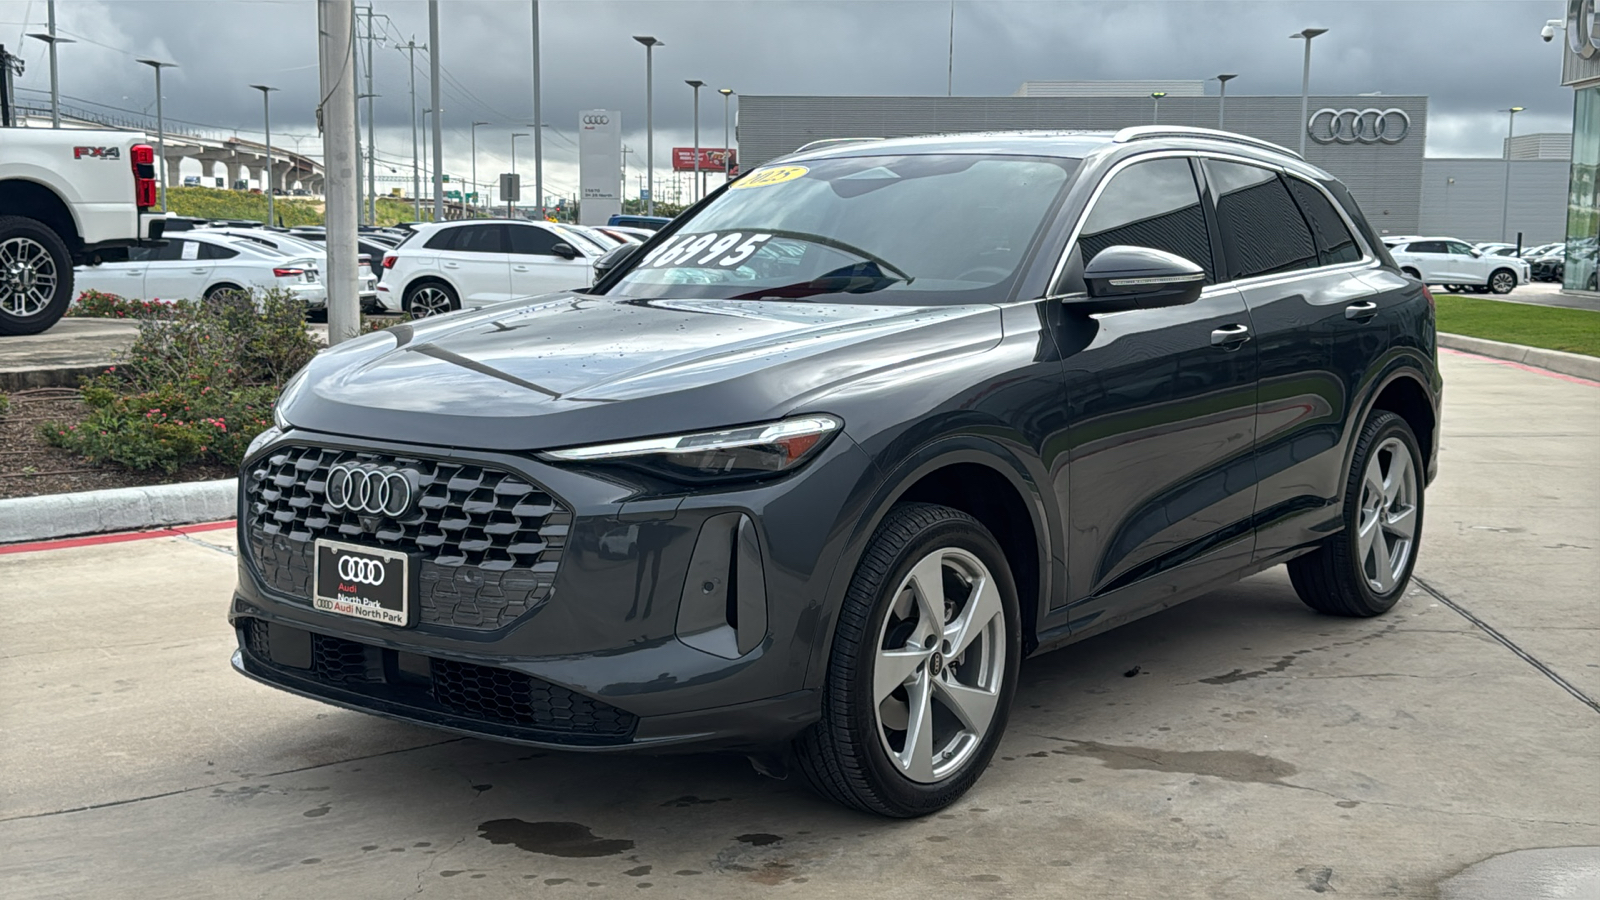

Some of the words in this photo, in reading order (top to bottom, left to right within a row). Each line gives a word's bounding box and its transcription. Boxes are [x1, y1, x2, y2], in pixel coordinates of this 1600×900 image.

[73, 146, 120, 160] FX4
[338, 583, 357, 594] Audi
[337, 593, 362, 605] North
[363, 598, 381, 608] Park
[334, 602, 354, 614] Audi
[355, 606, 381, 619] North
[383, 611, 403, 623] Park
